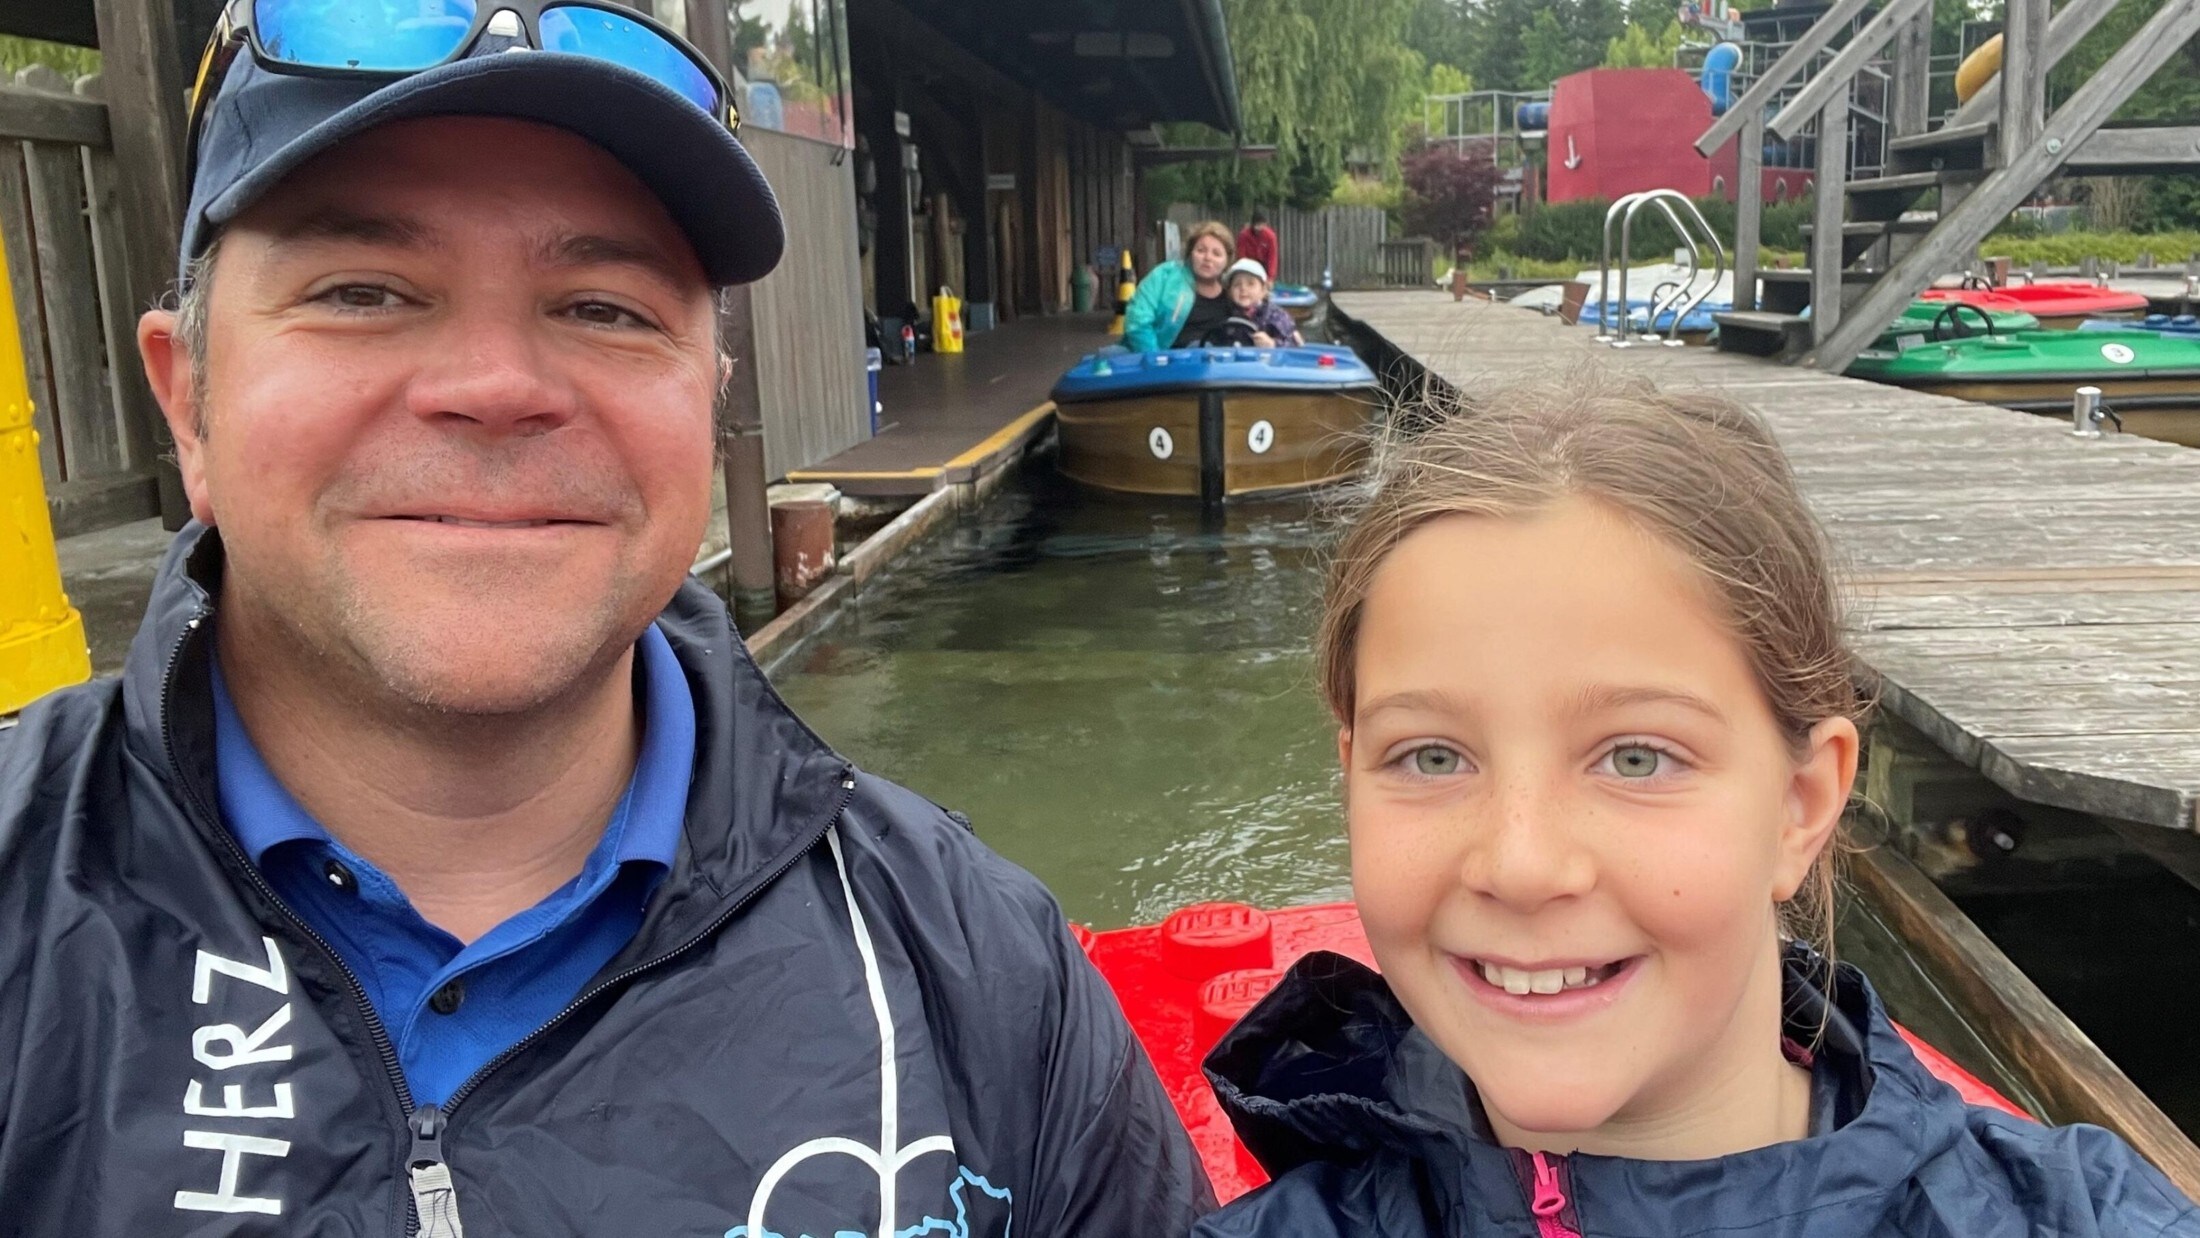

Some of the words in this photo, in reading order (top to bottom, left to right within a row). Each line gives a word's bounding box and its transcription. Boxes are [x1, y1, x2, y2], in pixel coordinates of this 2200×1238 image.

[1155, 435, 1165, 451] 4
[1255, 428, 1264, 445] 4
[173, 936, 294, 1215] HERZ
